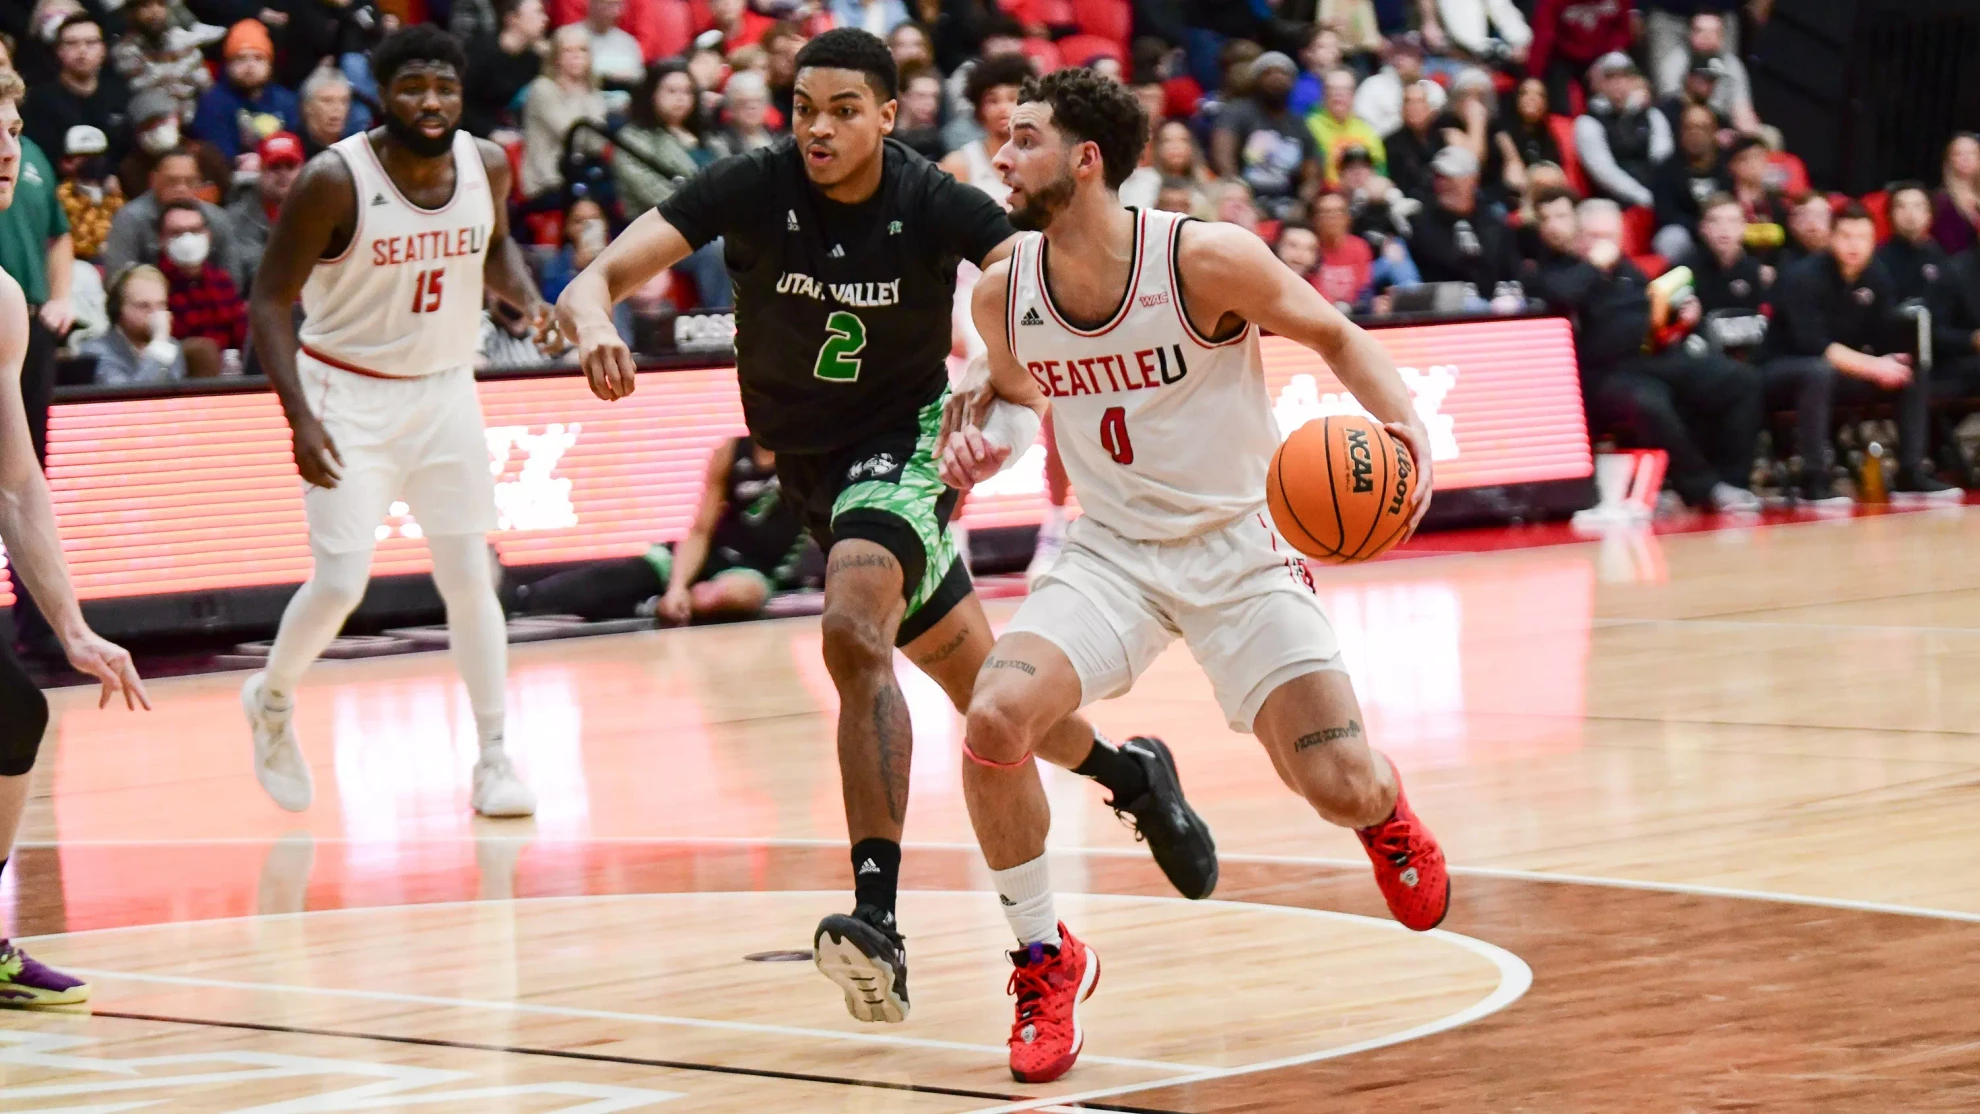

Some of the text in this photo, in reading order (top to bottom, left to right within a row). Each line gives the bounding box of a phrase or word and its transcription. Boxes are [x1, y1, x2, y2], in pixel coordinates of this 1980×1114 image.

[372, 224, 485, 266] SEATTLEU
[411, 267, 445, 314] 15
[829, 277, 901, 307] VALLEY
[1140, 291, 1169, 308] WAC
[813, 310, 867, 382] 2
[1027, 344, 1188, 397] SEATTLEU
[1100, 406, 1134, 465] 0
[1345, 428, 1374, 493] NCAA
